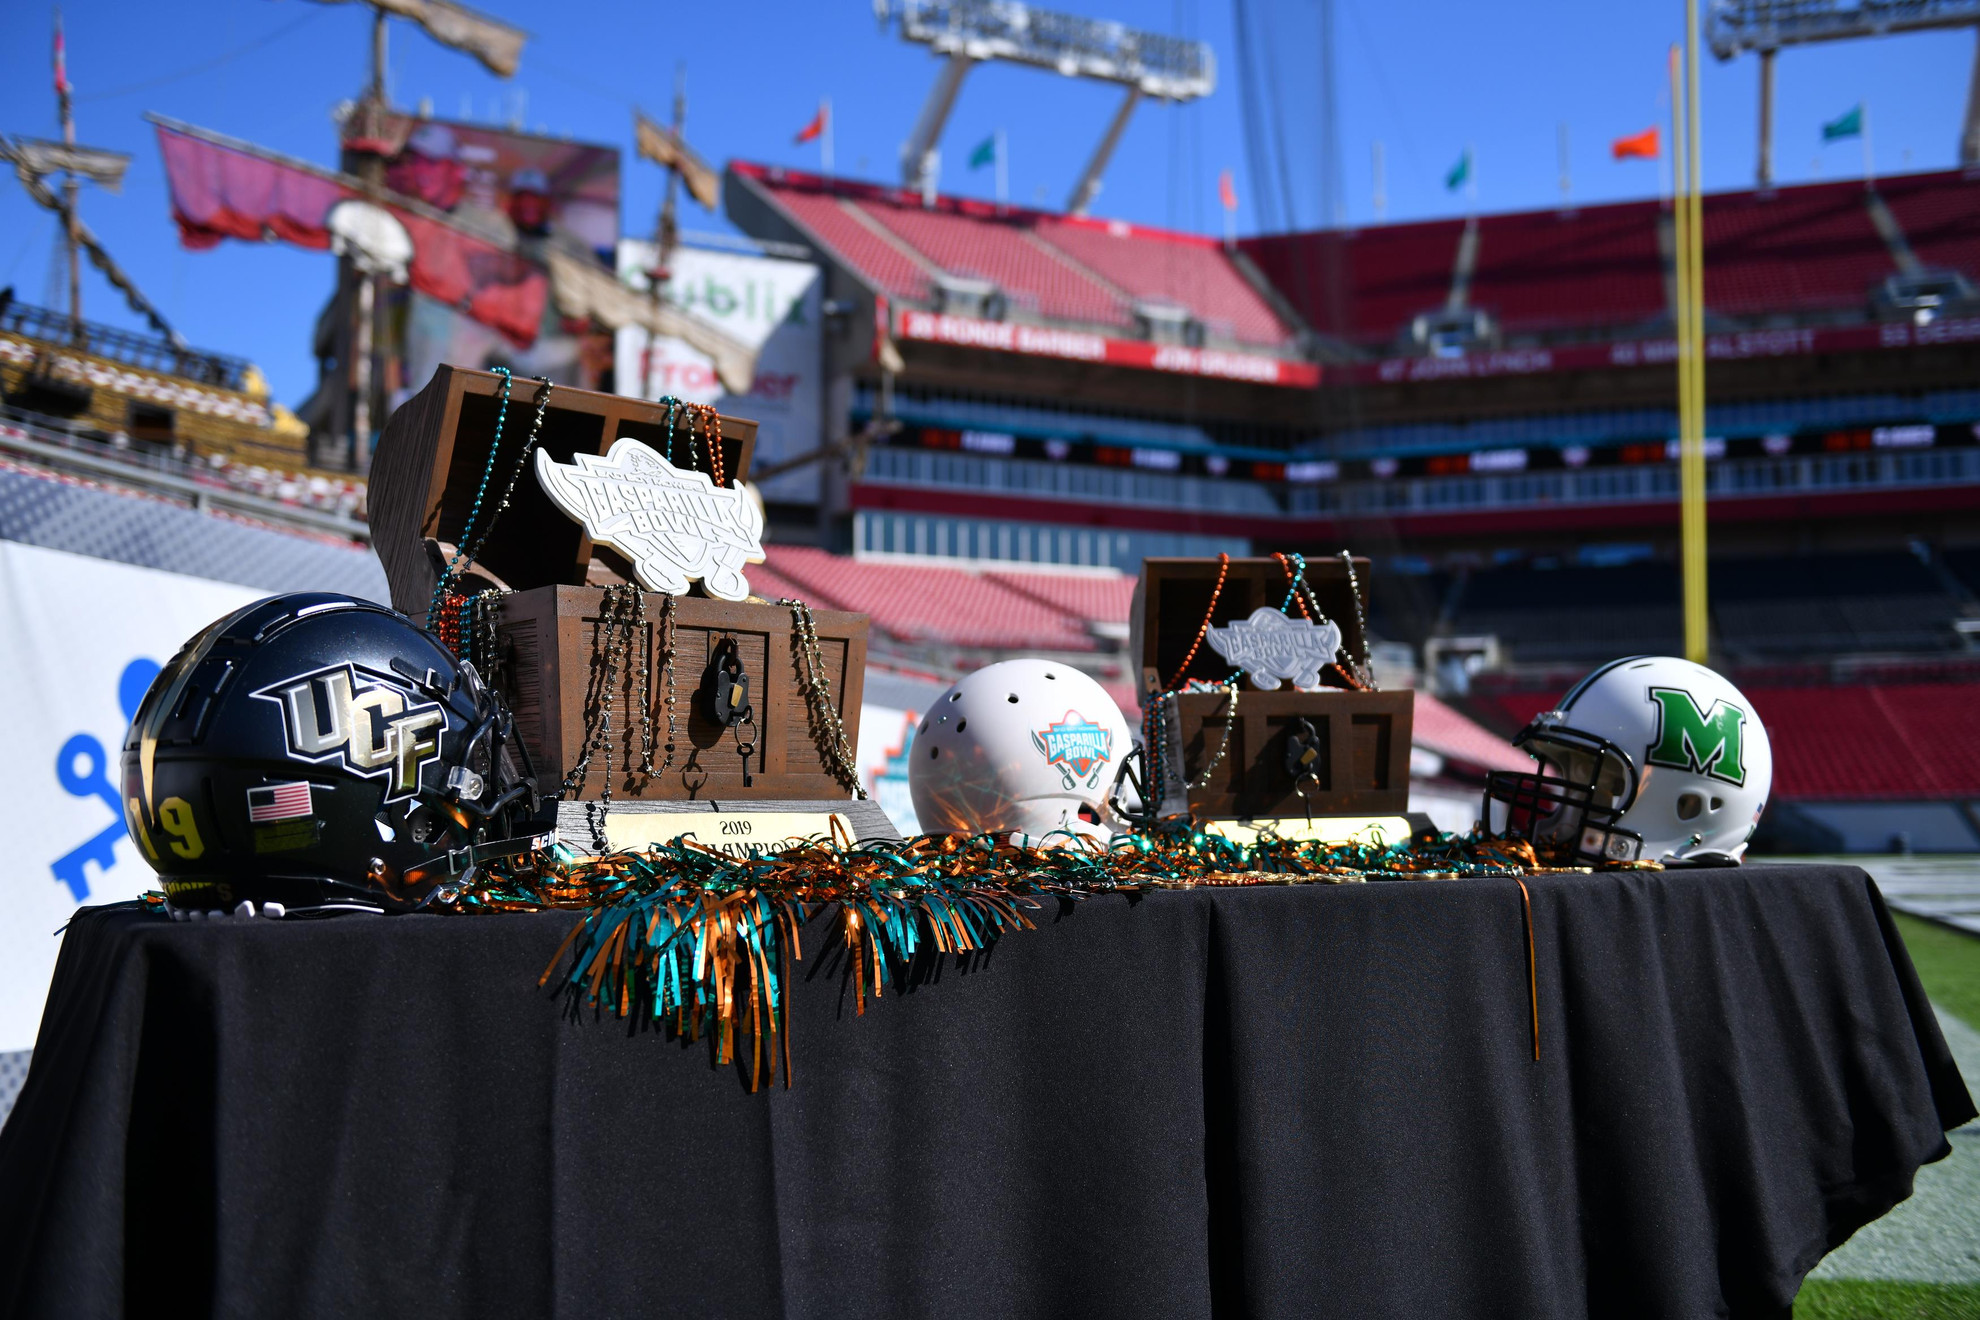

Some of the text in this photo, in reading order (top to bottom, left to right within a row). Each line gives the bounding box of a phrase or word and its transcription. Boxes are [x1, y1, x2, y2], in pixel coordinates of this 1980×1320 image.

[584, 477, 738, 531] GASPARILLA
[630, 509, 719, 544] BOWL
[1229, 631, 1324, 657] GASPARILLA
[249, 661, 449, 804] UCF
[1047, 732, 1109, 758] GASPARILLA
[1645, 686, 1747, 787] M
[1065, 745, 1097, 761] BOWL
[719, 820, 752, 836] 2019
